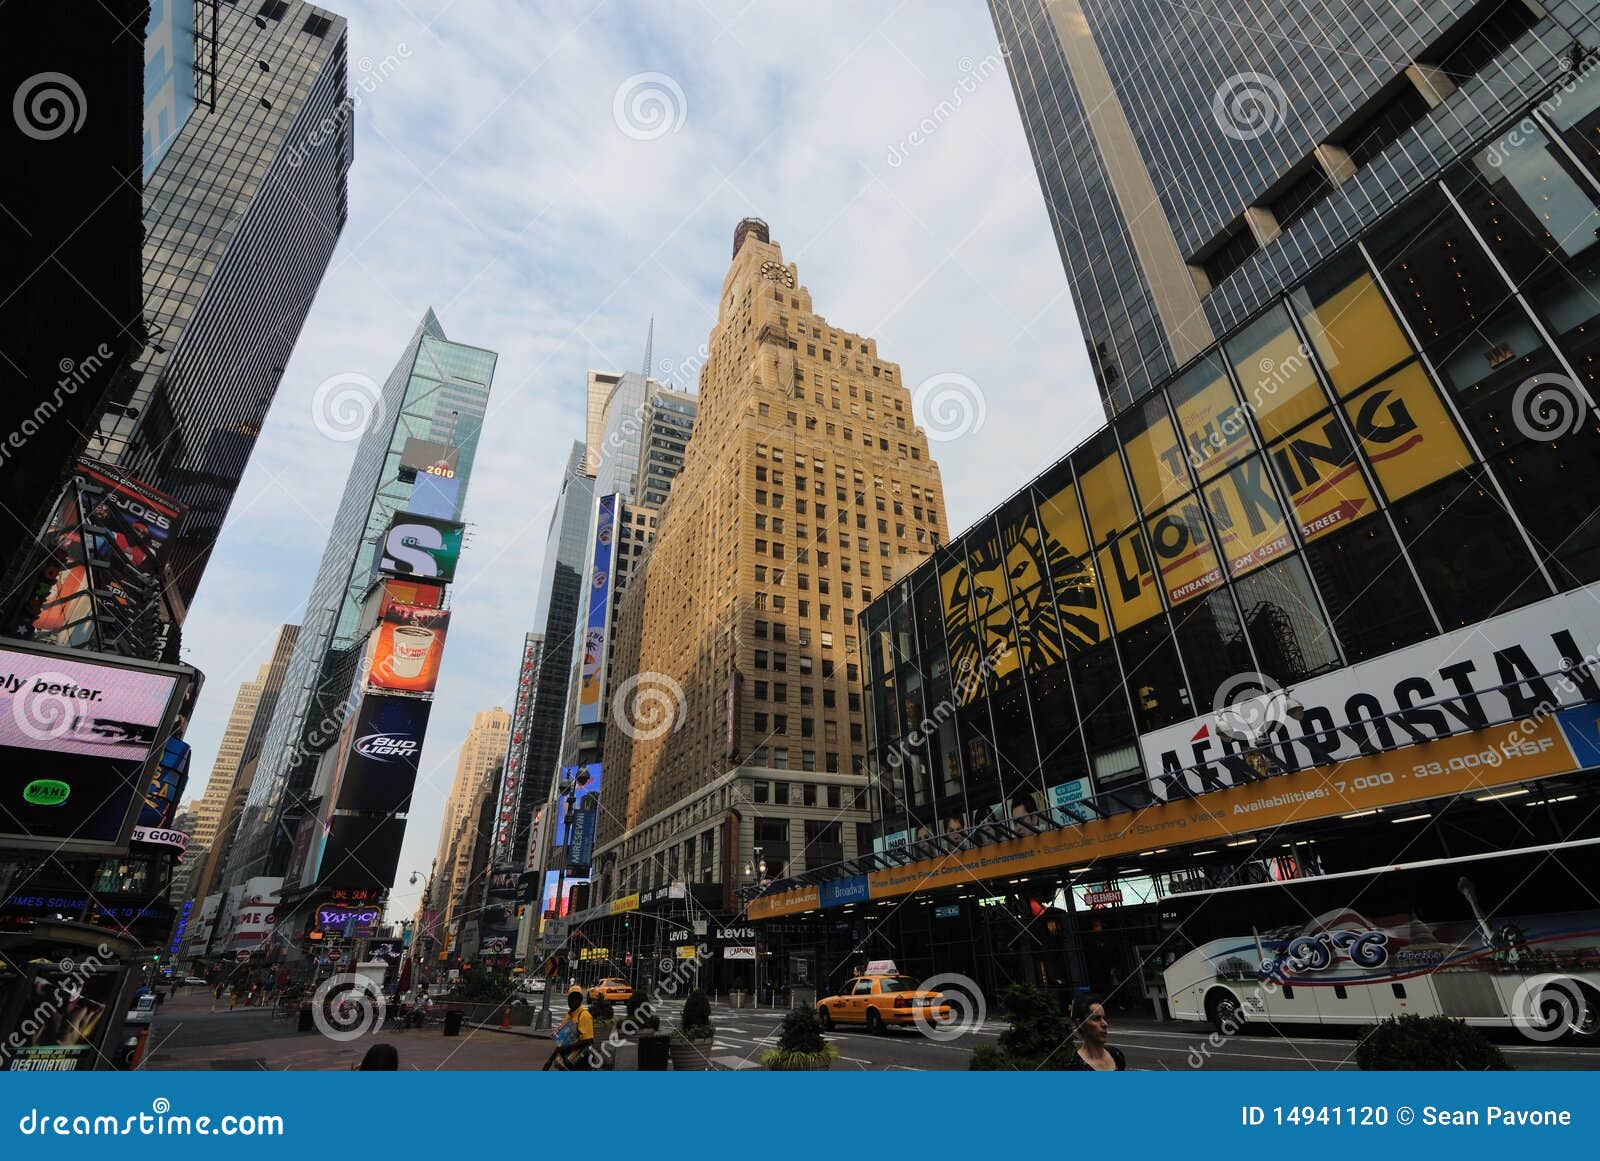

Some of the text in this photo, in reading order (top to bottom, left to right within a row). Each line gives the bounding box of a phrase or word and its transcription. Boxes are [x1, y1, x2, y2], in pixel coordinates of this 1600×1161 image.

[1160, 405, 1251, 477] THE
[426, 465, 455, 478] 2010
[1107, 390, 1418, 602] LION KING
[116, 499, 171, 530] JOES
[1172, 510, 1342, 600] ENTRANCE ON 45TH STREET
[33, 678, 103, 702] better.
[371, 737, 418, 748] BUD
[363, 744, 418, 757] LIGHT
[30, 785, 68, 796] WAHL
[980, 849, 1036, 867] Environment
[1135, 817, 1188, 835] Stunning
[1190, 808, 1226, 825] Views
[1232, 787, 1331, 816] Availabilities:
[1333, 771, 1395, 794] 7,000
[1412, 751, 1497, 780] 33,000
[149, 829, 182, 844] GOOD
[834, 883, 866, 900] Broadway
[1092, 891, 1122, 904] ELEMENT
[320, 910, 379, 925] YAHOO!
[10, 1058, 79, 1072] DESTINATION
